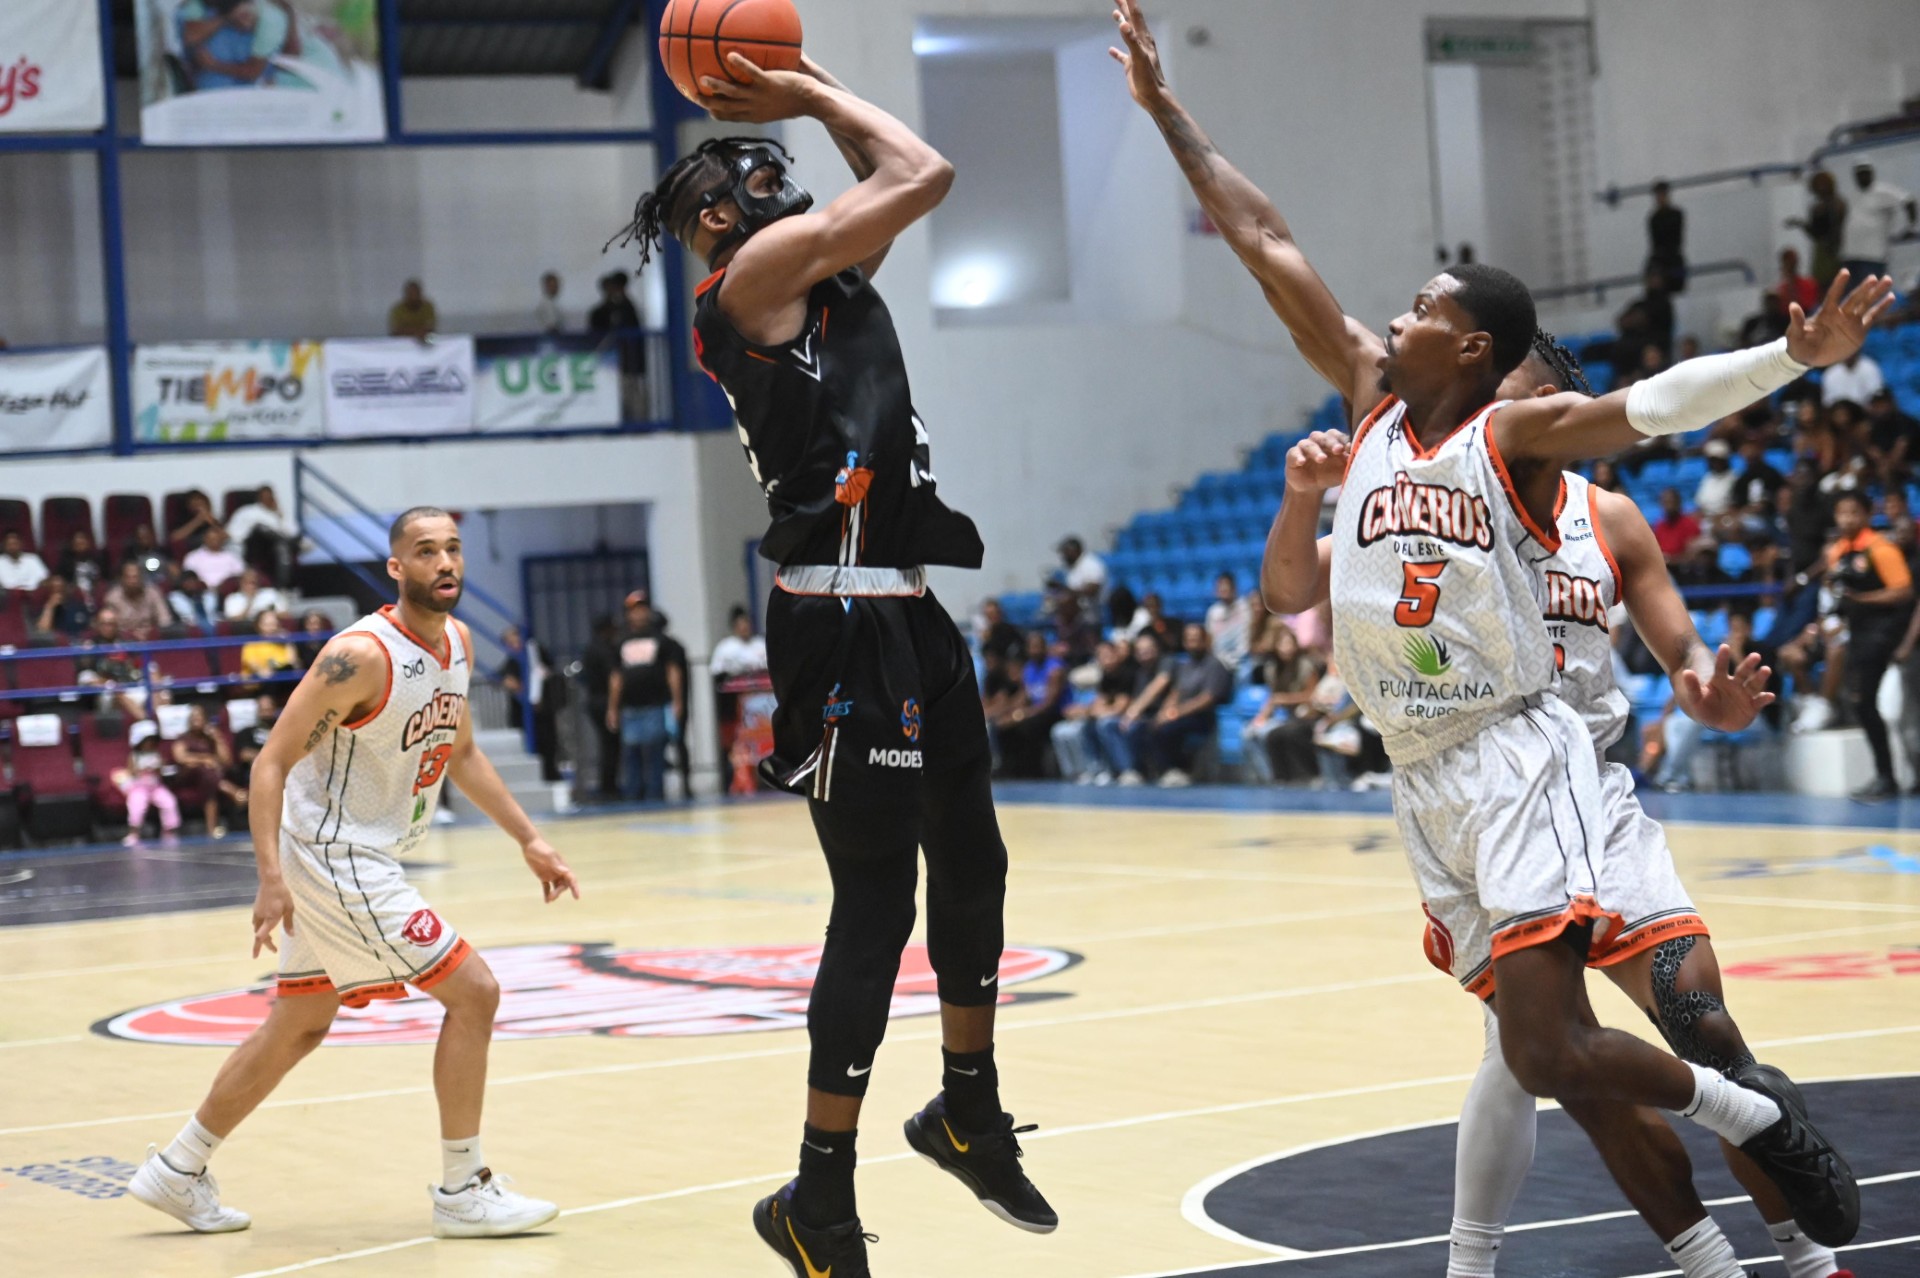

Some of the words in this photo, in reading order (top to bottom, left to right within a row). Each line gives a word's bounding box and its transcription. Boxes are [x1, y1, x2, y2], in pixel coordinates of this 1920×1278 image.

[0, 56, 40, 115] y's
[157, 367, 303, 412] TIEMPO
[1418, 542, 1445, 557] ESTE
[1394, 559, 1450, 628] 5
[1380, 680, 1495, 701] PUNTACANA
